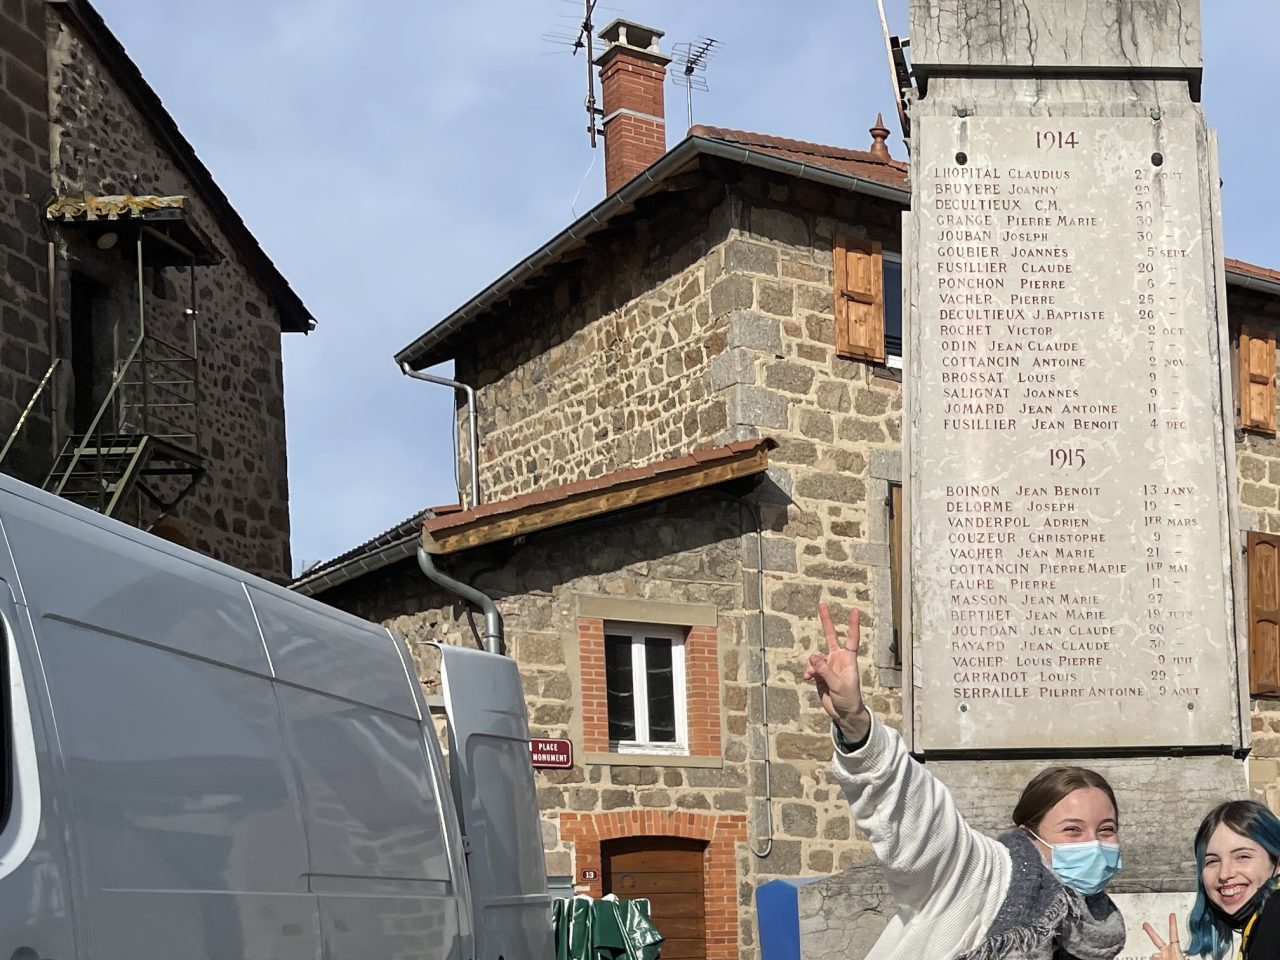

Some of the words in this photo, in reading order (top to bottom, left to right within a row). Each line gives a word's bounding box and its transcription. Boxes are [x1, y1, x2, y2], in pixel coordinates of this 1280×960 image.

[1035, 130, 1079, 152] 1914
[934, 168, 1001, 179] LHOPITAL
[1008, 168, 1070, 179] CLAUDIUS
[935, 184, 1001, 195] BRUYERE
[1008, 184, 1059, 195] JOANNY
[935, 200, 1021, 211] DECULTIEUX
[936, 214, 992, 226] GRANGE
[1007, 215, 1052, 227] PIERRE
[1057, 216, 1097, 227] MARIE
[937, 231, 991, 242] JOUBAN
[1002, 231, 1048, 242] JOSEPH
[1137, 231, 1153, 241] 30
[937, 247, 999, 258] GOUBIER
[937, 262, 1007, 273] FUSILLIER
[1021, 263, 1072, 274] CLAUDE
[1137, 263, 1154, 273] 20
[938, 278, 1004, 289] PONCHON
[1021, 278, 1066, 289] PIERRE
[939, 294, 992, 305] VACHER
[1011, 294, 1055, 305] PIERRE
[1138, 294, 1154, 305] 25
[940, 309, 1025, 320] DECULTIEUX
[1138, 310, 1154, 320] 26
[940, 325, 992, 336] ROCHET
[1007, 325, 1054, 336] VICTOR
[941, 341, 977, 352] ODIN
[988, 341, 1023, 352] JEAN
[1028, 341, 1078, 352] CLAUDE
[942, 356, 1019, 367] COTTANCIN
[1032, 357, 1085, 367] ANTOINE
[942, 372, 1003, 383] BROSSAT
[1018, 372, 1056, 383] LOUIS
[943, 388, 1009, 399] SALIGNAT
[1023, 388, 1080, 399] JOANNES
[944, 403, 1004, 415] JOMARD
[1019, 403, 1052, 415] JEAN
[1061, 404, 1118, 415] ANTOINE
[944, 419, 1017, 430] FUSILLIER
[1032, 419, 1065, 430] JEAN
[1073, 419, 1119, 430] BENOIT
[1050, 448, 1086, 471] 1915
[946, 485, 1000, 497] BOINON
[1015, 485, 1048, 497] JEAN
[1054, 486, 1101, 497] BENOIT
[1143, 485, 1158, 496] 13
[946, 501, 1013, 513] DELORME
[1027, 501, 1075, 512] JOSEPH
[948, 517, 1030, 528] VANDERPOL
[1044, 517, 1090, 527] ADRIEN
[1167, 518, 1198, 527] MARS
[948, 532, 1016, 544] COUZEUR
[1028, 533, 1106, 543] CHRISTOPHE
[950, 548, 1003, 559] VACHER
[1017, 548, 1048, 559] JEAN
[1055, 548, 1095, 558] MARIE
[1146, 547, 1160, 558] 21
[949, 563, 1029, 574] COTTANCIN
[1040, 564, 1085, 574] PIERRE
[1087, 564, 1127, 574] MARIE
[949, 579, 994, 590] FAURE
[1011, 579, 1057, 590] PIERRE
[950, 595, 1008, 605] MASSON
[1021, 595, 1055, 606] JEAN
[1060, 595, 1100, 605] MARIE
[951, 610, 1011, 621] BERTHET
[1025, 610, 1057, 621] JEAN
[1066, 610, 1106, 620] MARIE
[1147, 609, 1161, 620] 19
[951, 625, 1018, 636] JOURDAN
[1029, 625, 1062, 636] JEAN
[1069, 625, 1116, 636] CLAUDE
[1148, 624, 1164, 635] 20
[1021, 641, 1057, 651] JEAN
[1061, 641, 1110, 651] CLAUDE
[952, 656, 1003, 667] VACHER
[1016, 656, 1053, 667] LOUIS
[1058, 656, 1103, 666] PIERRE
[953, 672, 1028, 683] CARRADOT
[1040, 672, 1077, 683] LOUIS
[1151, 670, 1166, 681] 29
[953, 687, 1029, 699] SERRAILLE
[1039, 688, 1084, 698] PIERRE
[1089, 686, 1144, 697] ANTOINE
[538, 743, 558, 752] PLACE
[533, 753, 567, 762] MONUMENT
[585, 871, 594, 879] 13
